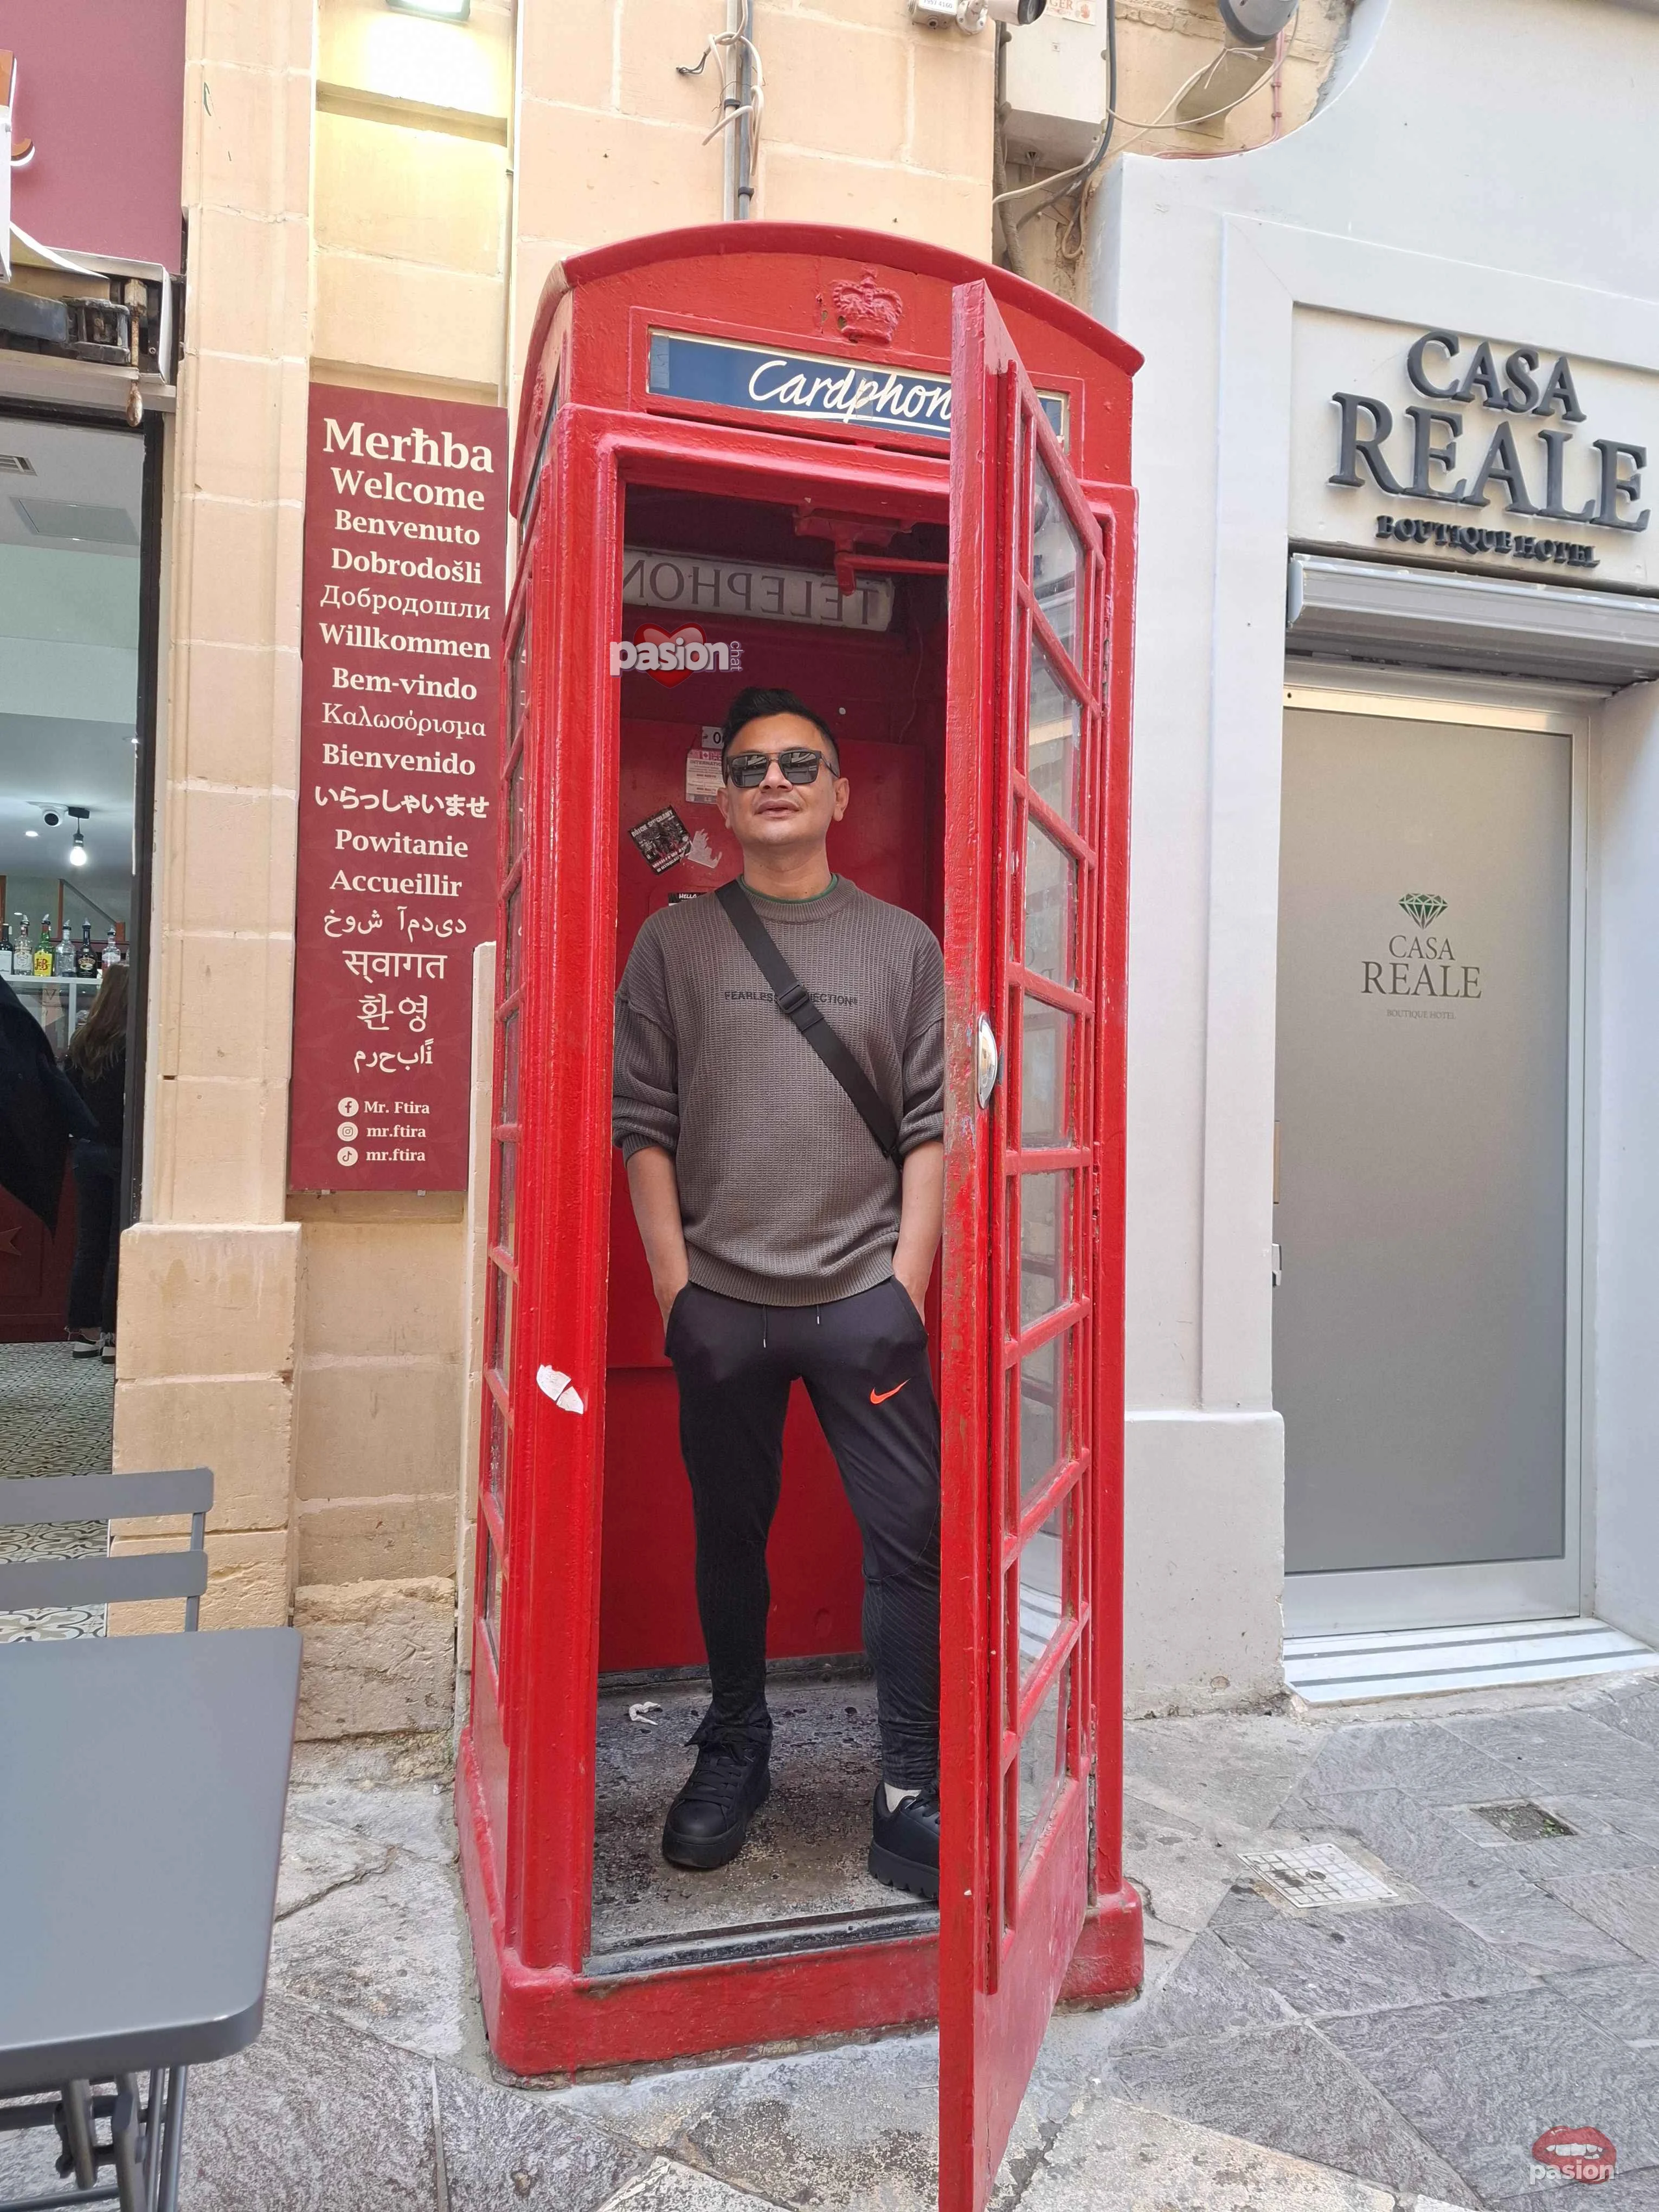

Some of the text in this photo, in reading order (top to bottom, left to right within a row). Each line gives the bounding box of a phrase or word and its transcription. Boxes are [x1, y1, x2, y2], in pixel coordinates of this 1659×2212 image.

[1049, 0, 1073, 10] GER
[748, 359, 952, 424] Cardphon
[1408, 331, 1587, 422] CASA
[323, 419, 494, 473] Merħba
[1328, 391, 1650, 532] REALE
[331, 467, 485, 511] Welcome
[335, 510, 480, 545] Benvenuto
[1376, 515, 1600, 568] BOUTIQUE HOTEL
[332, 548, 482, 584] Dobrodošli
[320, 585, 491, 620] Добродошли
[319, 623, 491, 659] Willkommen
[332, 667, 477, 700] Bem-vindo
[322, 703, 486, 739] Καλωσόρισμα
[322, 744, 475, 775] Bienvenido
[315, 786, 489, 818] いらっしゃいませ
[335, 829, 468, 858] Powitanie
[329, 870, 462, 896] Accueillir
[1389, 935, 1456, 961] CASA
[1361, 961, 1482, 999] REALE
[357, 994, 428, 1032] 환영
[1387, 1009, 1456, 1020] BOUTIQUE HOTEL
[364, 1101, 430, 1114] Mr. Ftira
[366, 1125, 426, 1137] mr.ftira
[365, 1148, 426, 1161] mr.ftira
